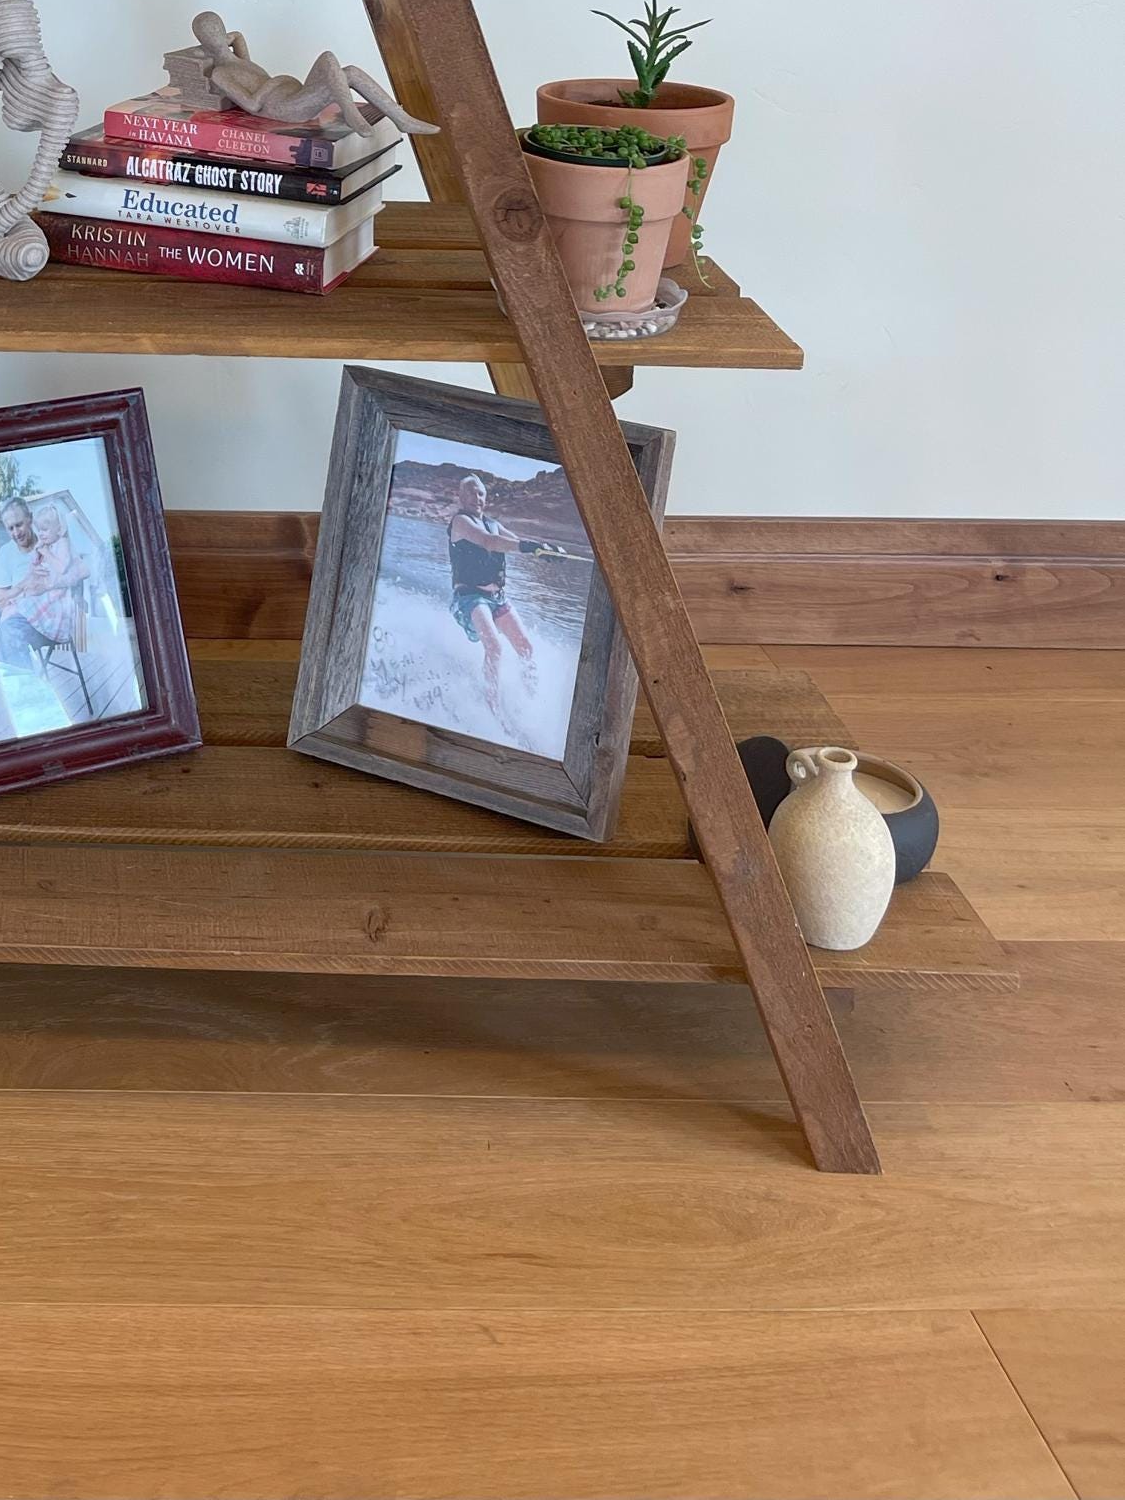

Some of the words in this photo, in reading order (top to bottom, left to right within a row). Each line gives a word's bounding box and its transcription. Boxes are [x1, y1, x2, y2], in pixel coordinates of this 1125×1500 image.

[123, 114, 160, 130] NEXT
[163, 119, 198, 135] YEAR
[221, 128, 269, 145] CHANEL
[138, 129, 193, 148] HAVANA
[217, 138, 271, 155] CLEETON
[66, 154, 108, 167] STANNARD
[126, 155, 192, 184] ALCATRAZ
[194, 164, 237, 189] GHOST
[240, 169, 284, 196] STORY
[121, 188, 239, 225] Educated
[117, 210, 154, 222] TARA
[163, 215, 241, 234] WESTOVER
[70, 223, 147, 248] KRISTIN
[66, 243, 150, 268] HANNAH
[158, 246, 183, 260] THE
[186, 245, 275, 274] WOMEN
